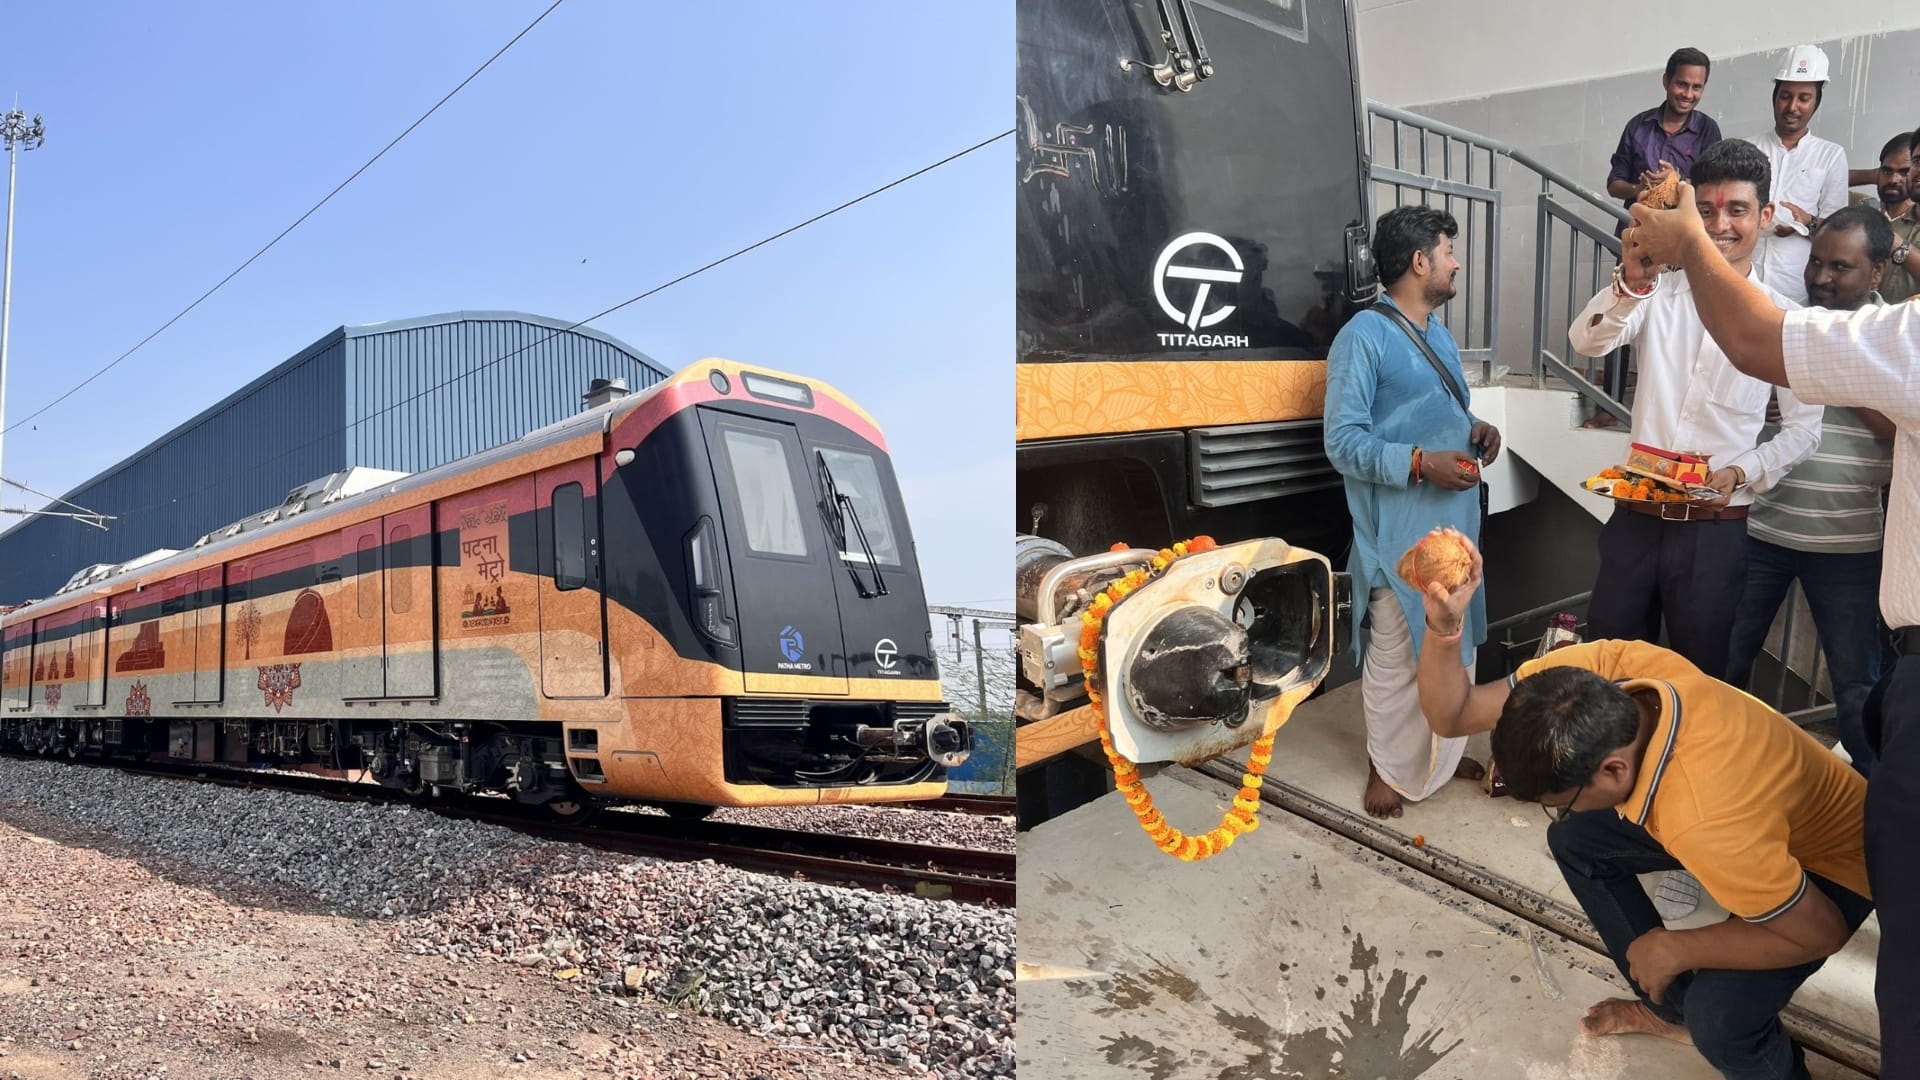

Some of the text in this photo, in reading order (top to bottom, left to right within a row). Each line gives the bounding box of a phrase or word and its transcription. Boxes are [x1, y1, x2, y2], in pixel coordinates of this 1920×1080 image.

[1157, 333, 1249, 347] TITAGARH
[462, 535, 497, 558] पटना
[477, 553, 504, 583] मेट्रो
[794, 662, 812, 670] METRO
